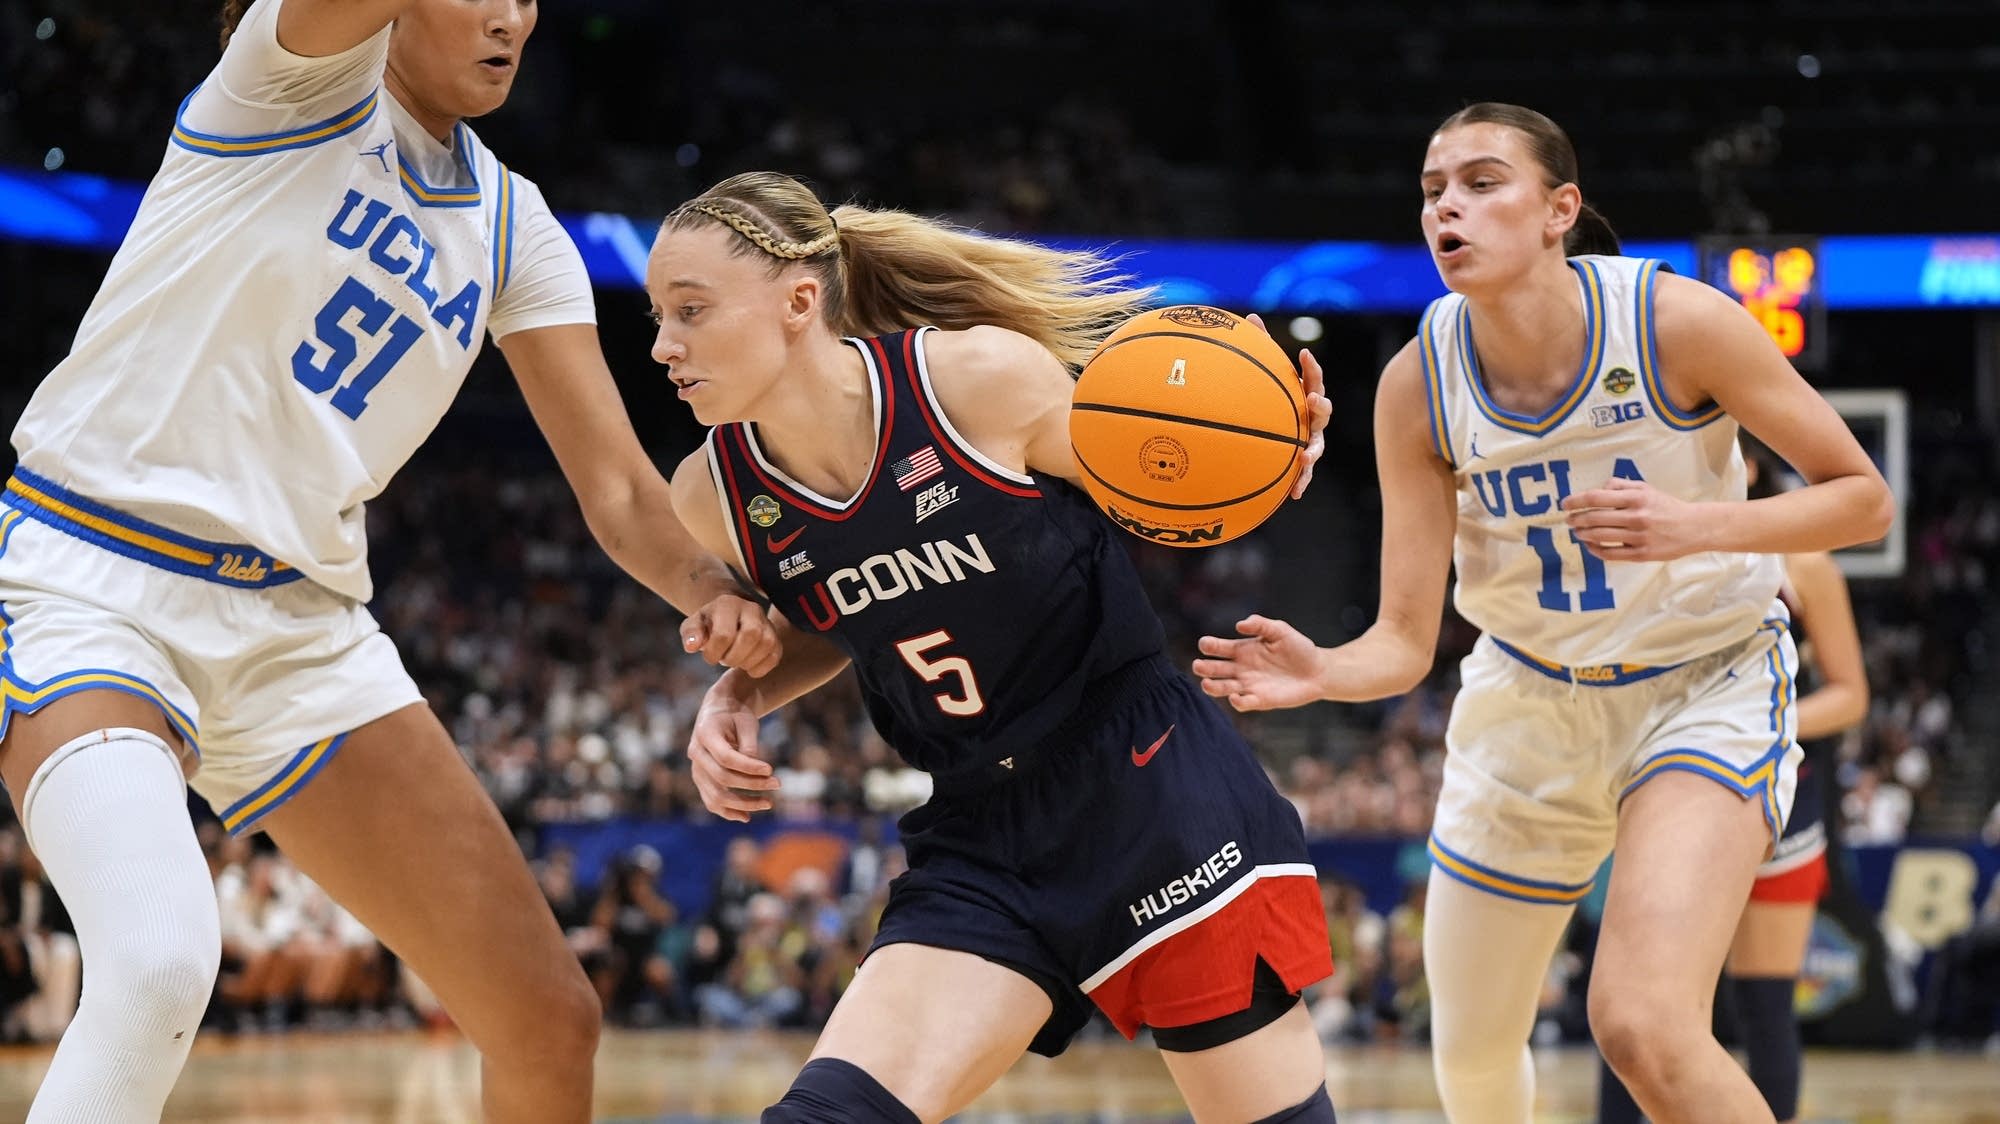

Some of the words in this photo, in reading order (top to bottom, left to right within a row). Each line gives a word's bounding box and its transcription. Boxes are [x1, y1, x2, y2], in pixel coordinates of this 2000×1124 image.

[327, 188, 482, 351] UCLA
[291, 275, 425, 421] 51
[915, 480, 946, 507] BIG
[915, 485, 959, 517] EAST
[1107, 504, 1224, 543] NCAA
[217, 552, 268, 582] Ucla
[779, 558, 791, 572] BE
[791, 550, 808, 566] THE
[781, 560, 815, 580] CHANGE
[798, 533, 997, 632] UCONN
[1527, 525, 1616, 612] 11
[893, 628, 988, 718] 5
[1129, 841, 1243, 927] HUSKIES
